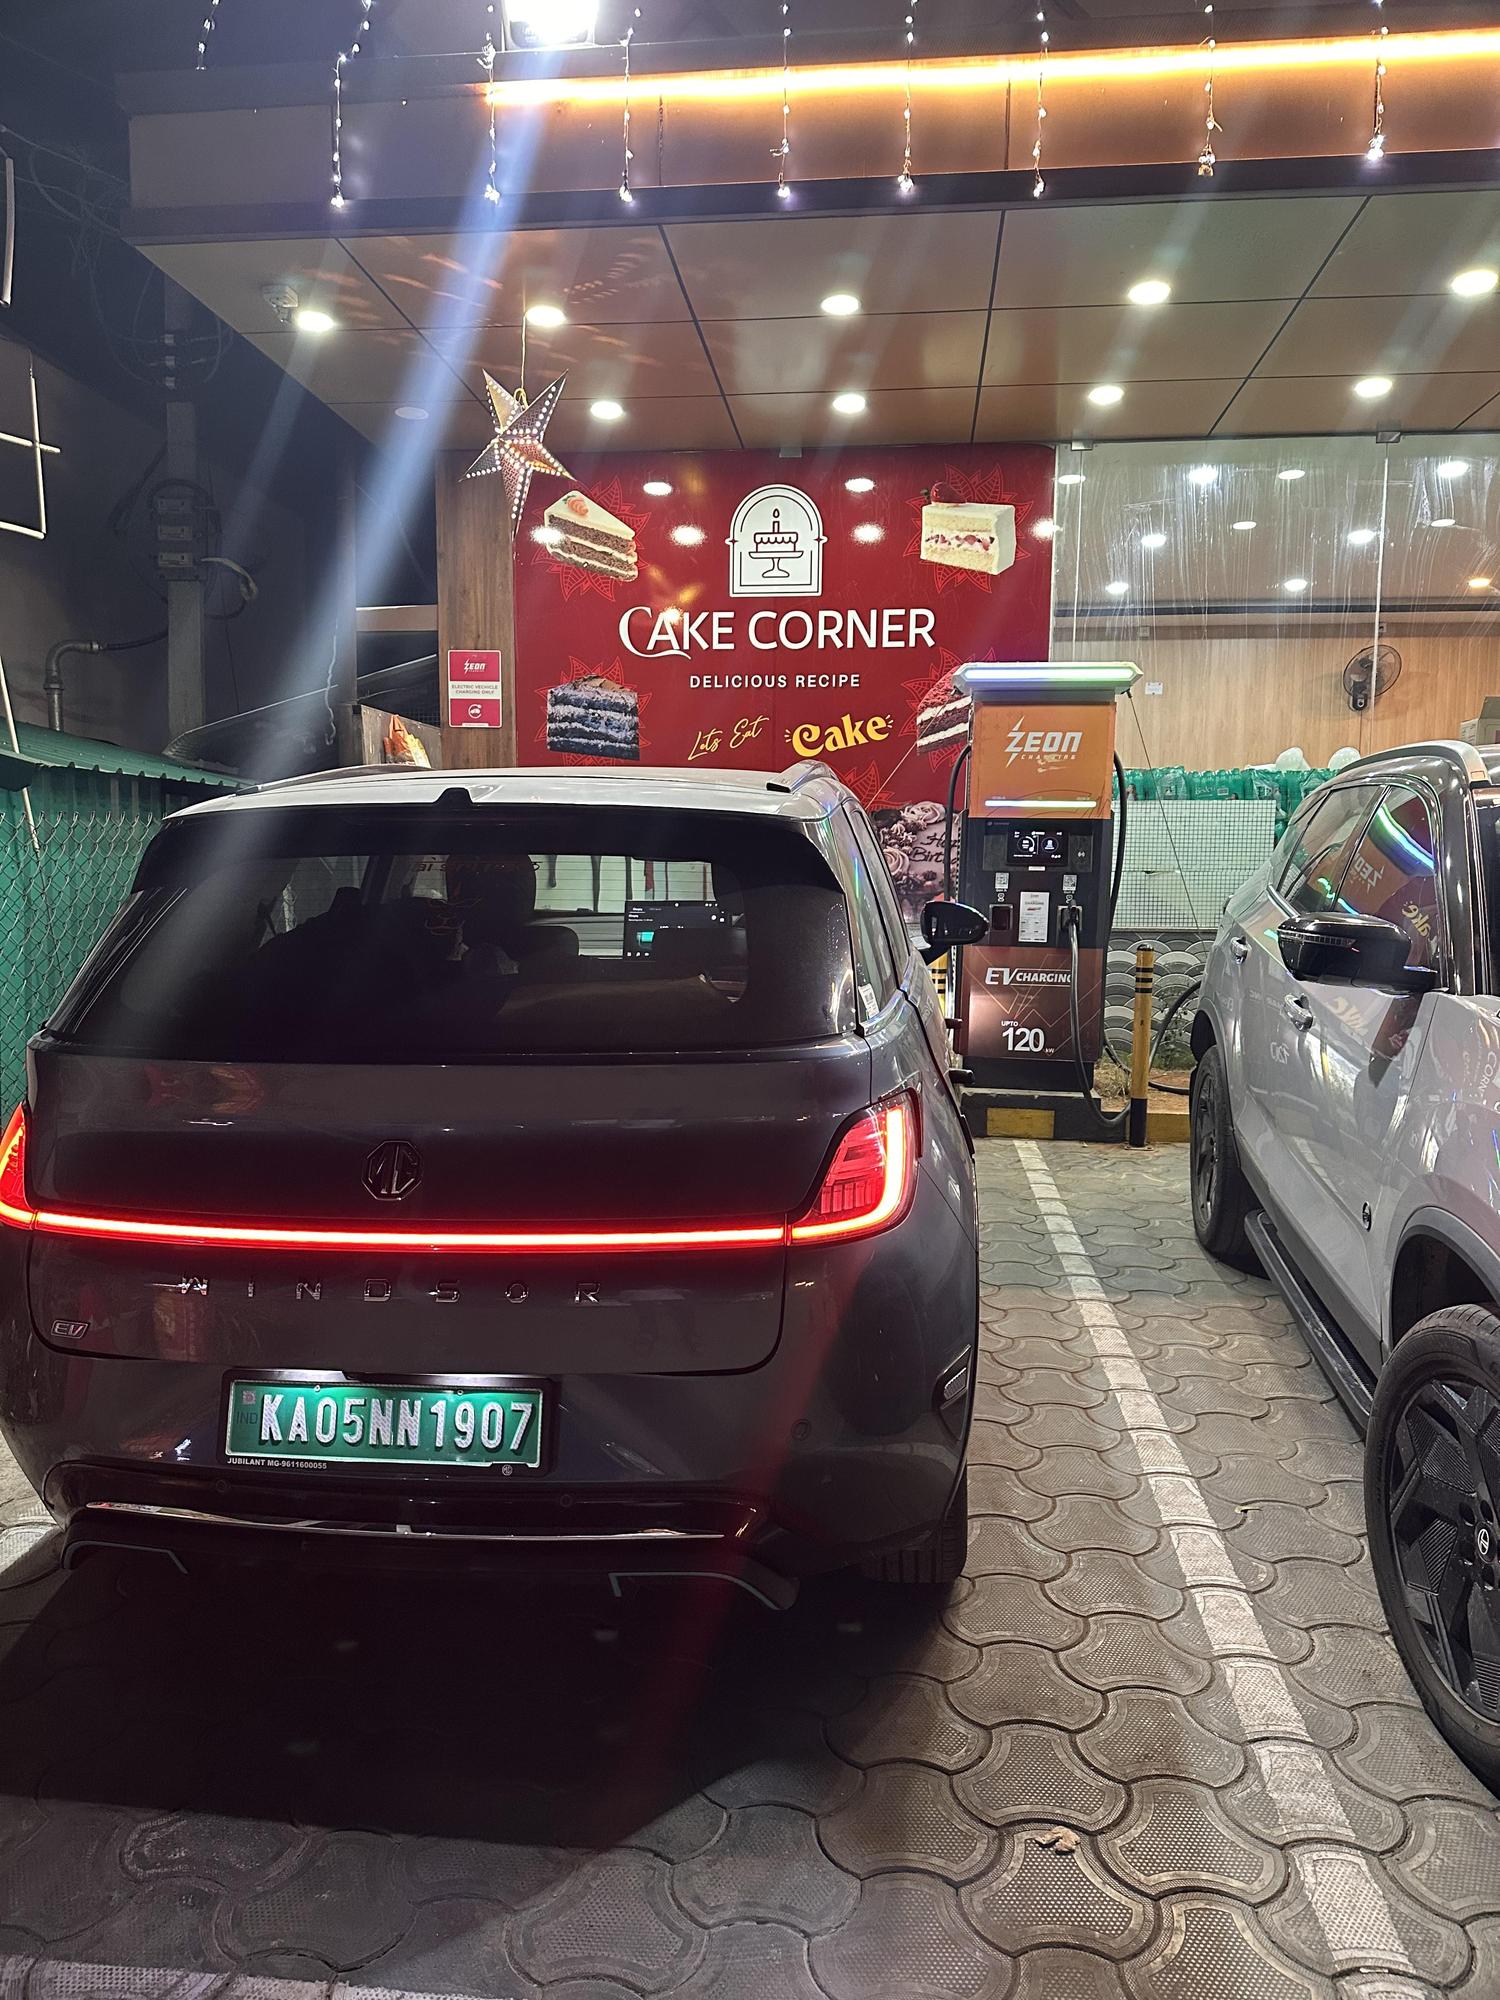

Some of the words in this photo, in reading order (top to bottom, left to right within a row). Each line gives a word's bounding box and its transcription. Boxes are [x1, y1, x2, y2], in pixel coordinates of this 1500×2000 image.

[619, 606, 735, 660] CAKE
[748, 608, 936, 650] CORNER
[464, 659, 486, 674] ZEON
[690, 674, 787, 688] DELICIOUS
[795, 673, 860, 688] RECIPE
[730, 715, 769, 748] Eat
[792, 713, 890, 757] Cake
[985, 967, 1019, 985] EV
[1002, 1027, 1045, 1052] 120
[180, 1277, 601, 1304] WINDSOR
[54, 1322, 85, 1336] EV
[236, 1411, 257, 1425] IND
[261, 1394, 533, 1450] KA05NN1907
[227, 1457, 265, 1467] JUBILANT
